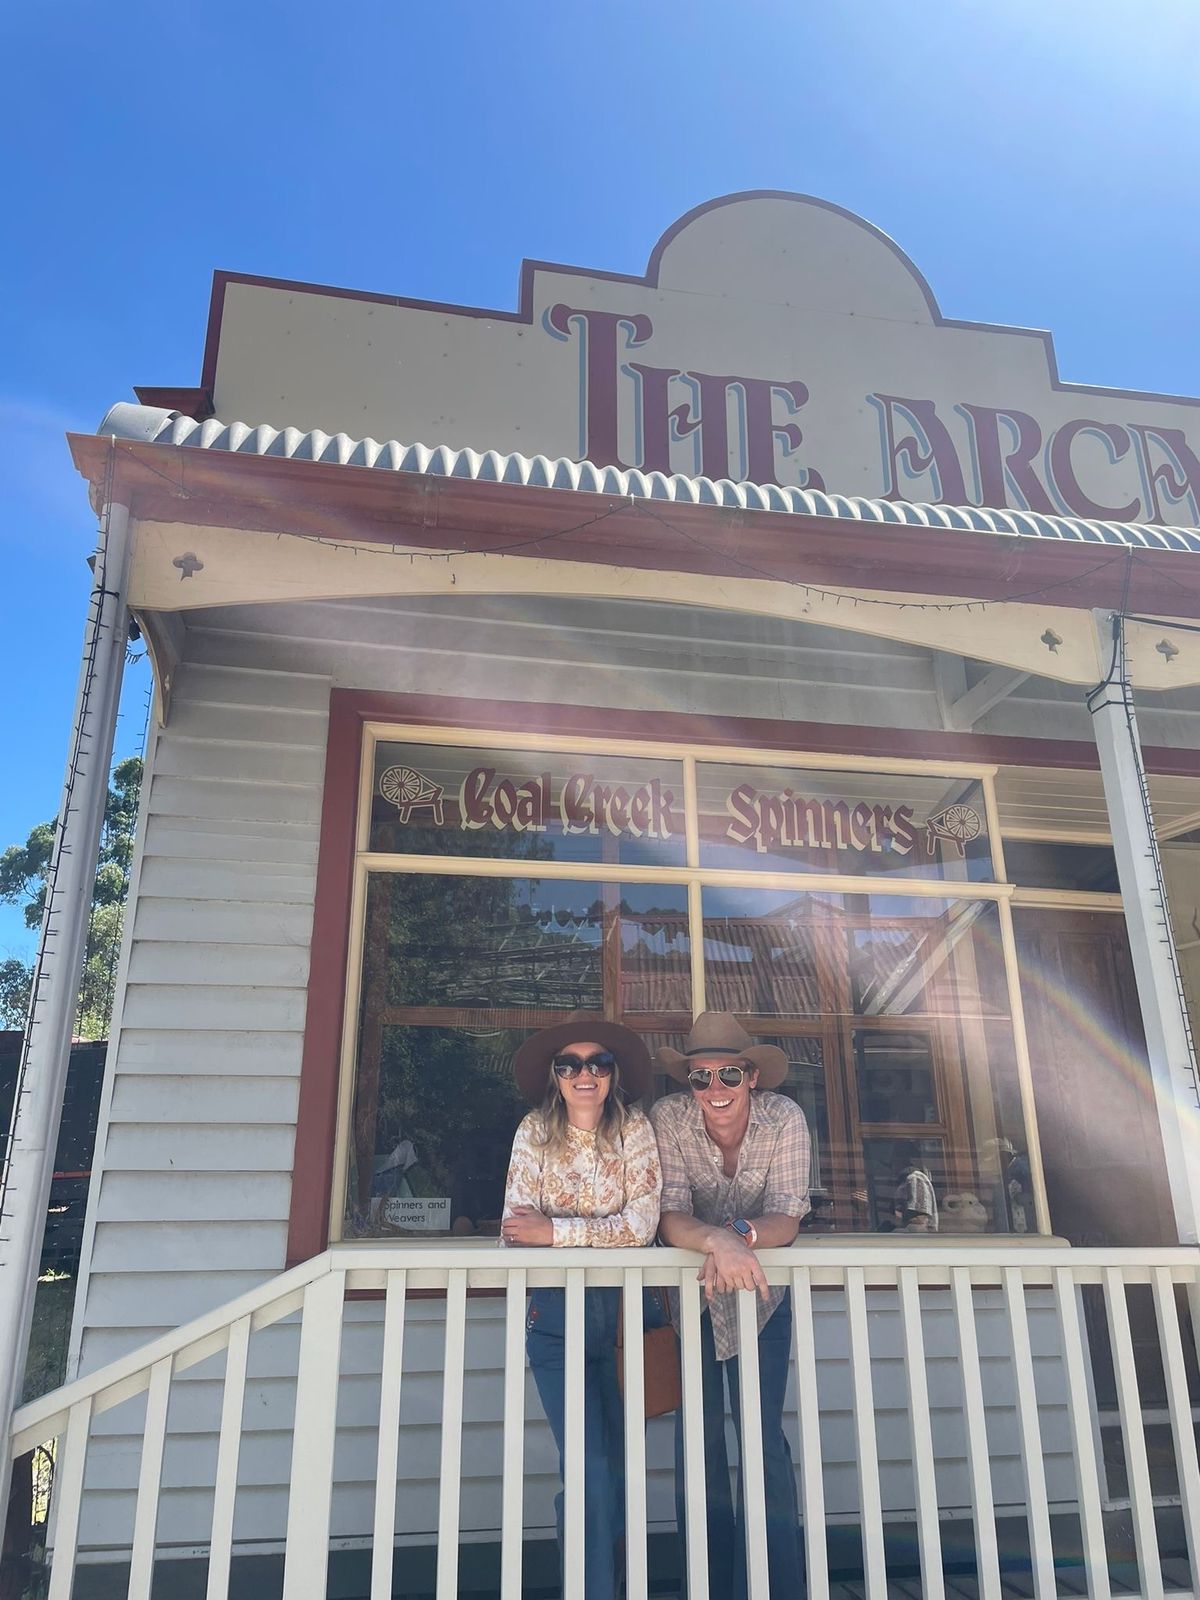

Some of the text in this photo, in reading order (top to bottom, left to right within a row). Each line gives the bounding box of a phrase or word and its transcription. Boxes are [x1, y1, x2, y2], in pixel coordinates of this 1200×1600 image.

[542, 303, 826, 493] THE
[459, 767, 914, 855] Coal Creek Spinners
[385, 1199, 446, 1211] Spinners and
